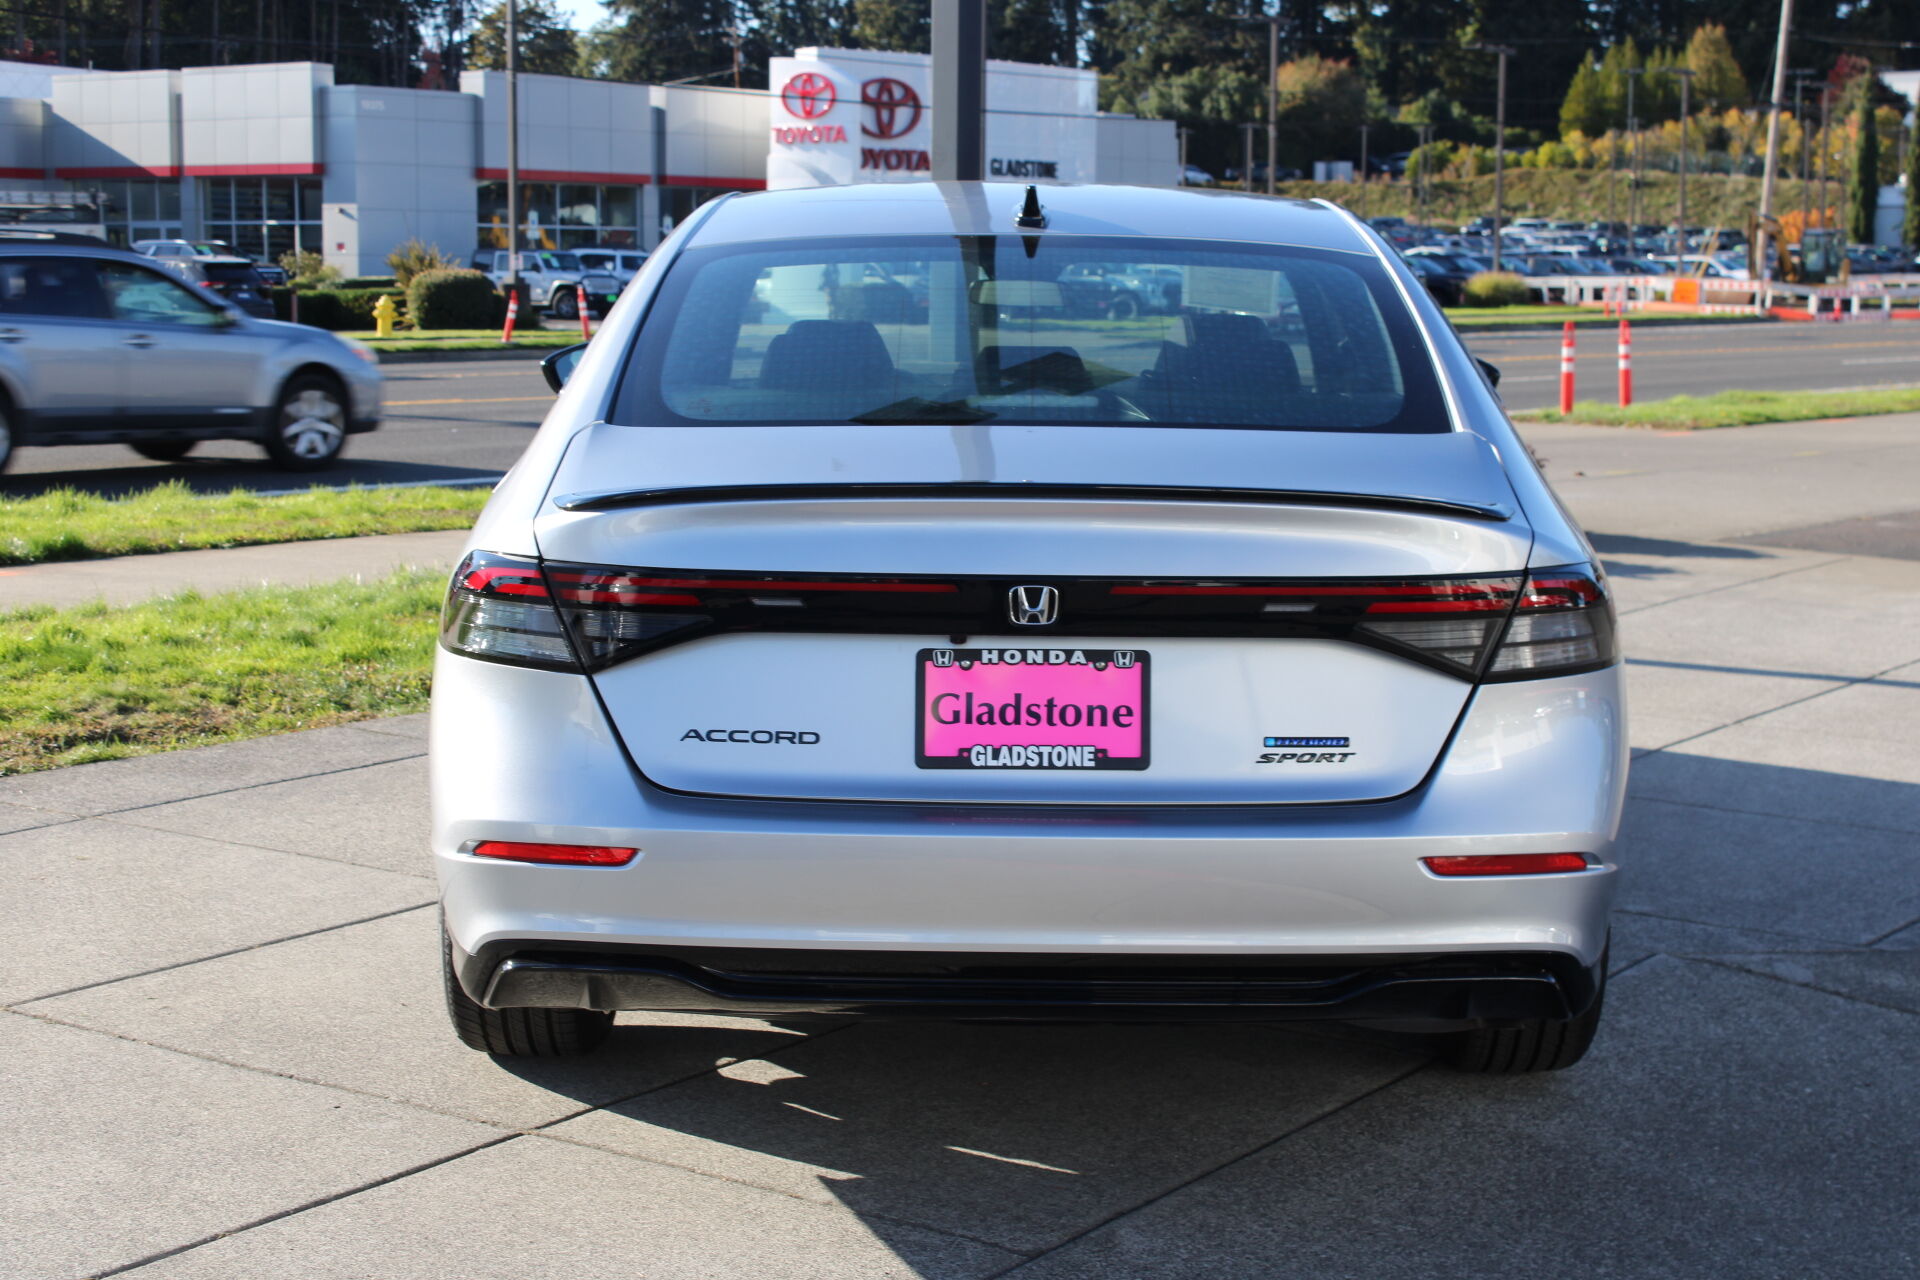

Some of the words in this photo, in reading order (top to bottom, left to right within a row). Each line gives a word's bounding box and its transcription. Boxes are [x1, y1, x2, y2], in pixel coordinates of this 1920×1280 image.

[773, 125, 847, 144] TOYOTA
[981, 650, 1087, 665] HONDA
[931, 692, 1134, 728] Gladstone
[680, 728, 821, 745] ACCORD
[970, 746, 1096, 768] GLADSTONE
[1255, 753, 1357, 764] SPORT
